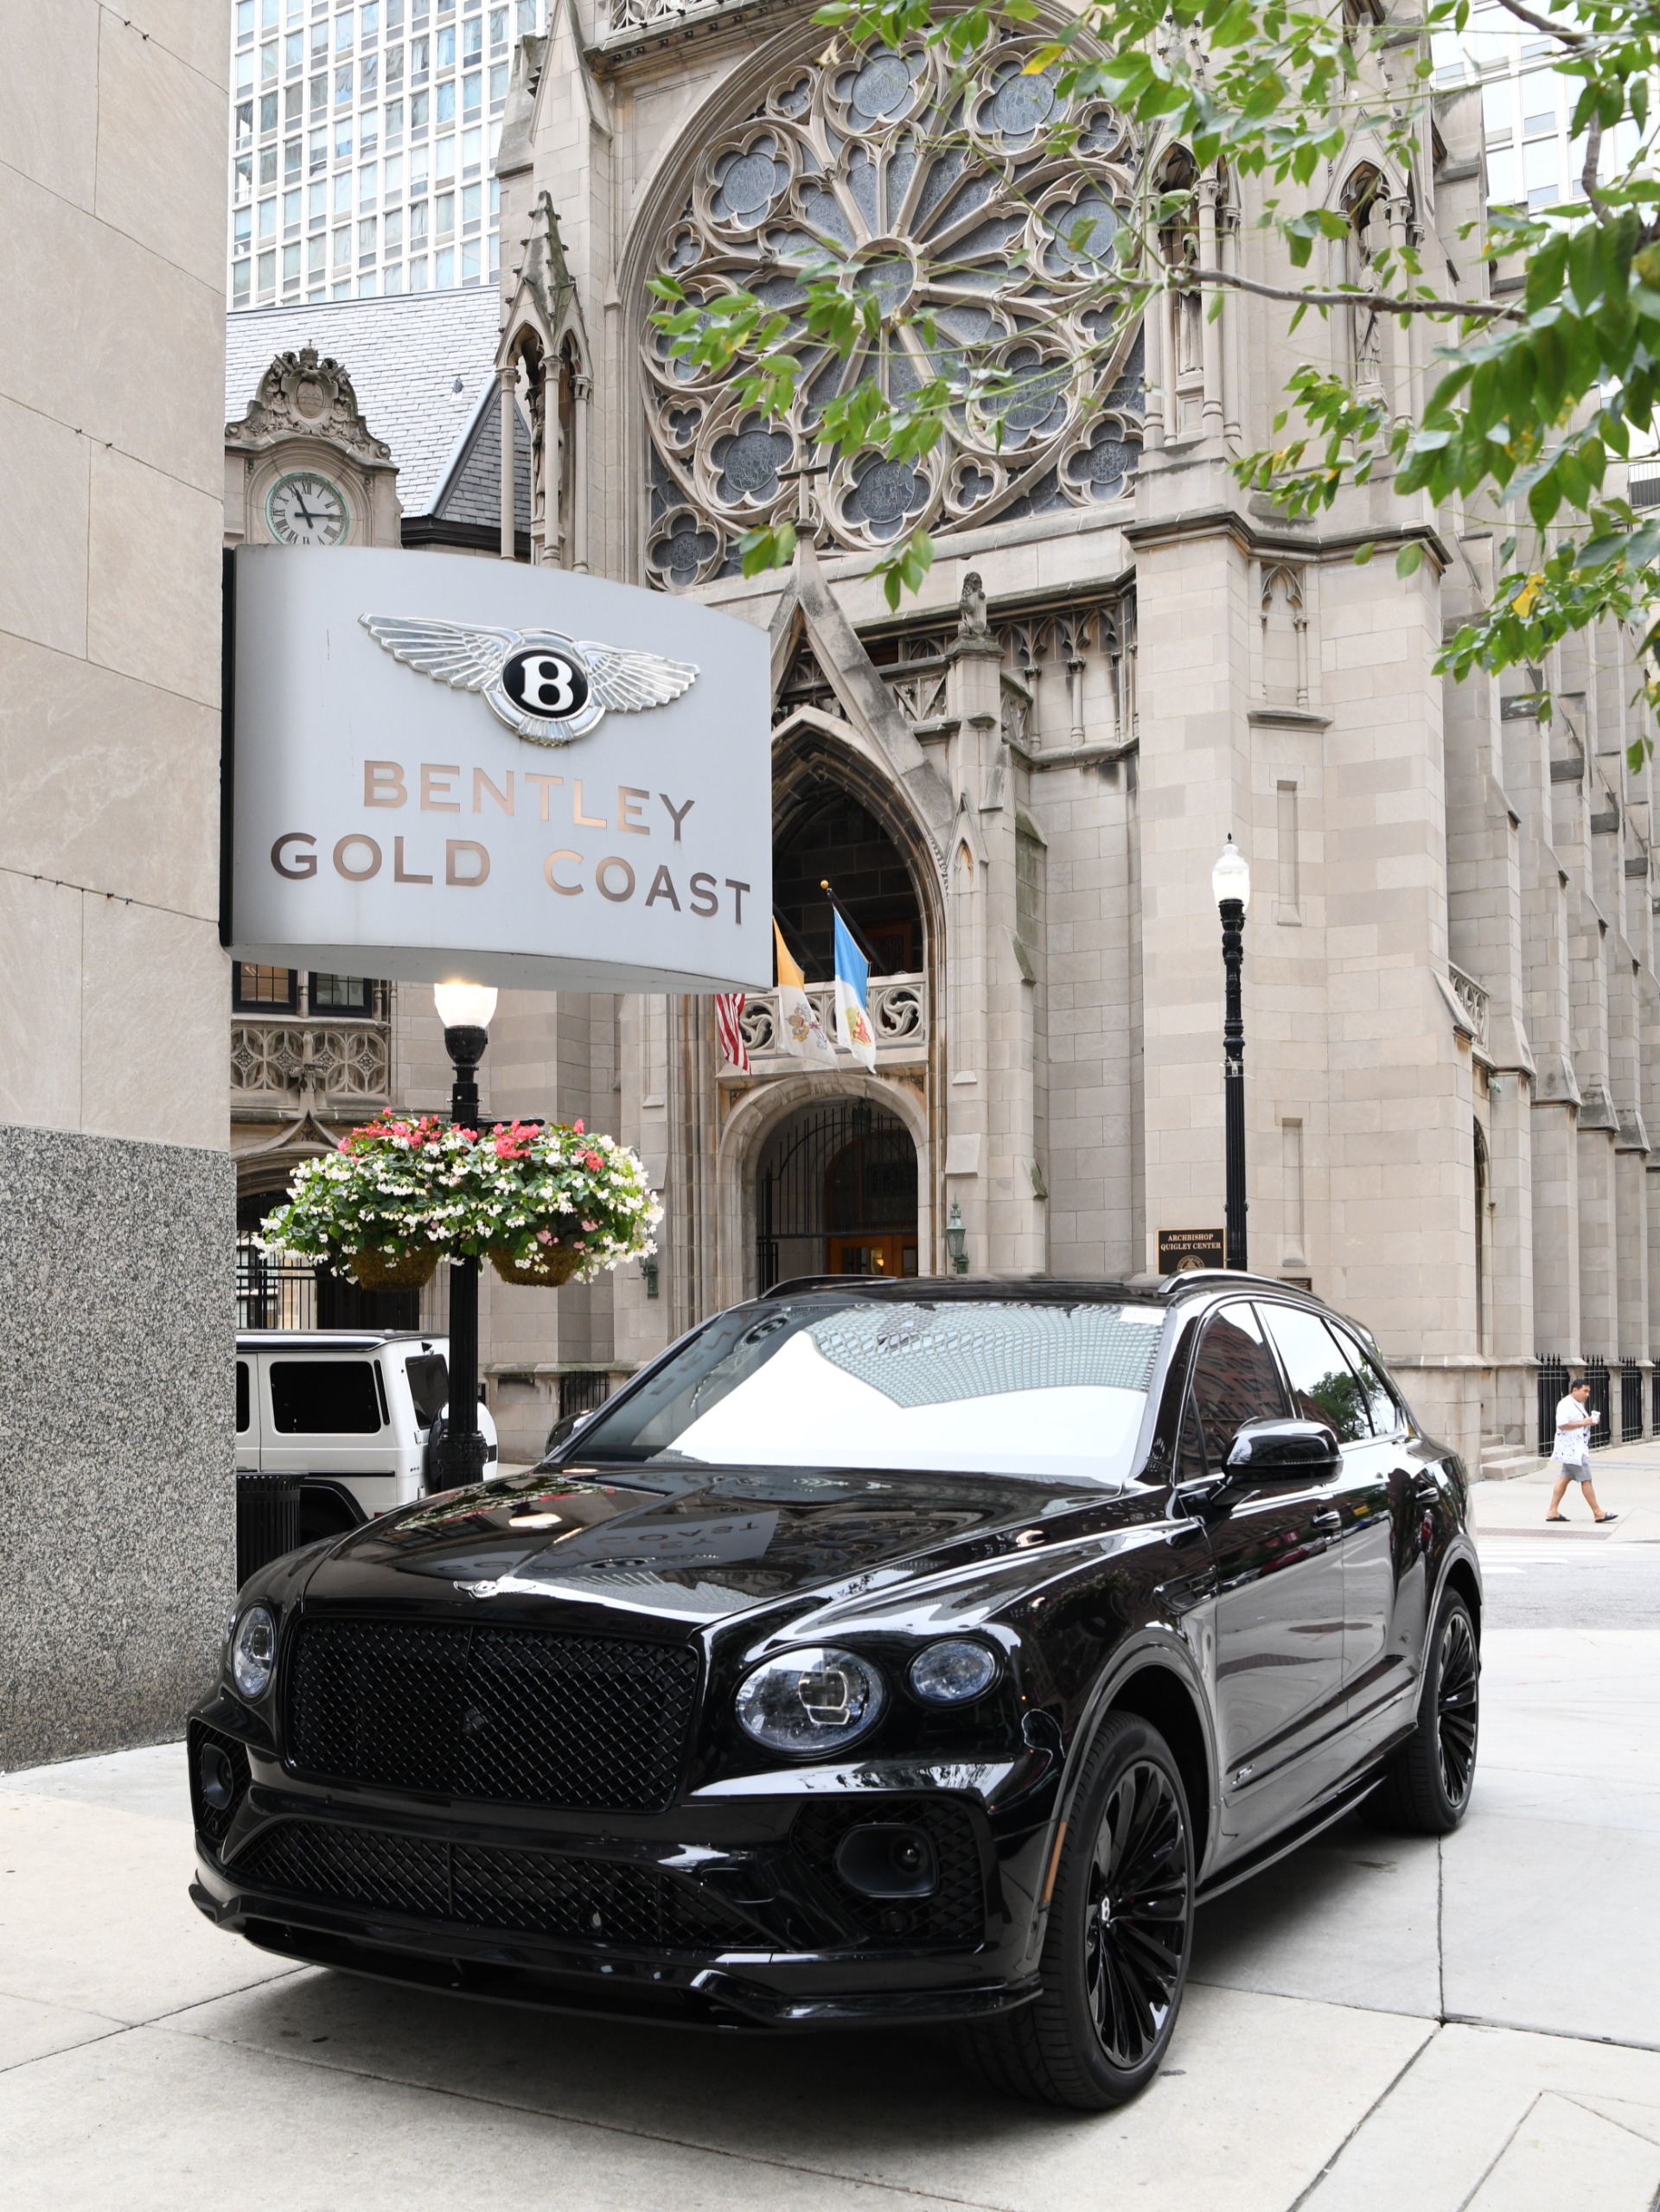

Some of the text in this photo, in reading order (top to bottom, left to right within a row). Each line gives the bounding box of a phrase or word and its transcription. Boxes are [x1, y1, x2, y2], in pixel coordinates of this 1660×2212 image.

[520, 654, 574, 712] B
[363, 760, 695, 842] BENTLEY
[271, 832, 751, 926] GOLD COAST
[1160, 1243, 1192, 1252] QUIGLEY
[1167, 1233, 1214, 1242] ARCHBISHOP
